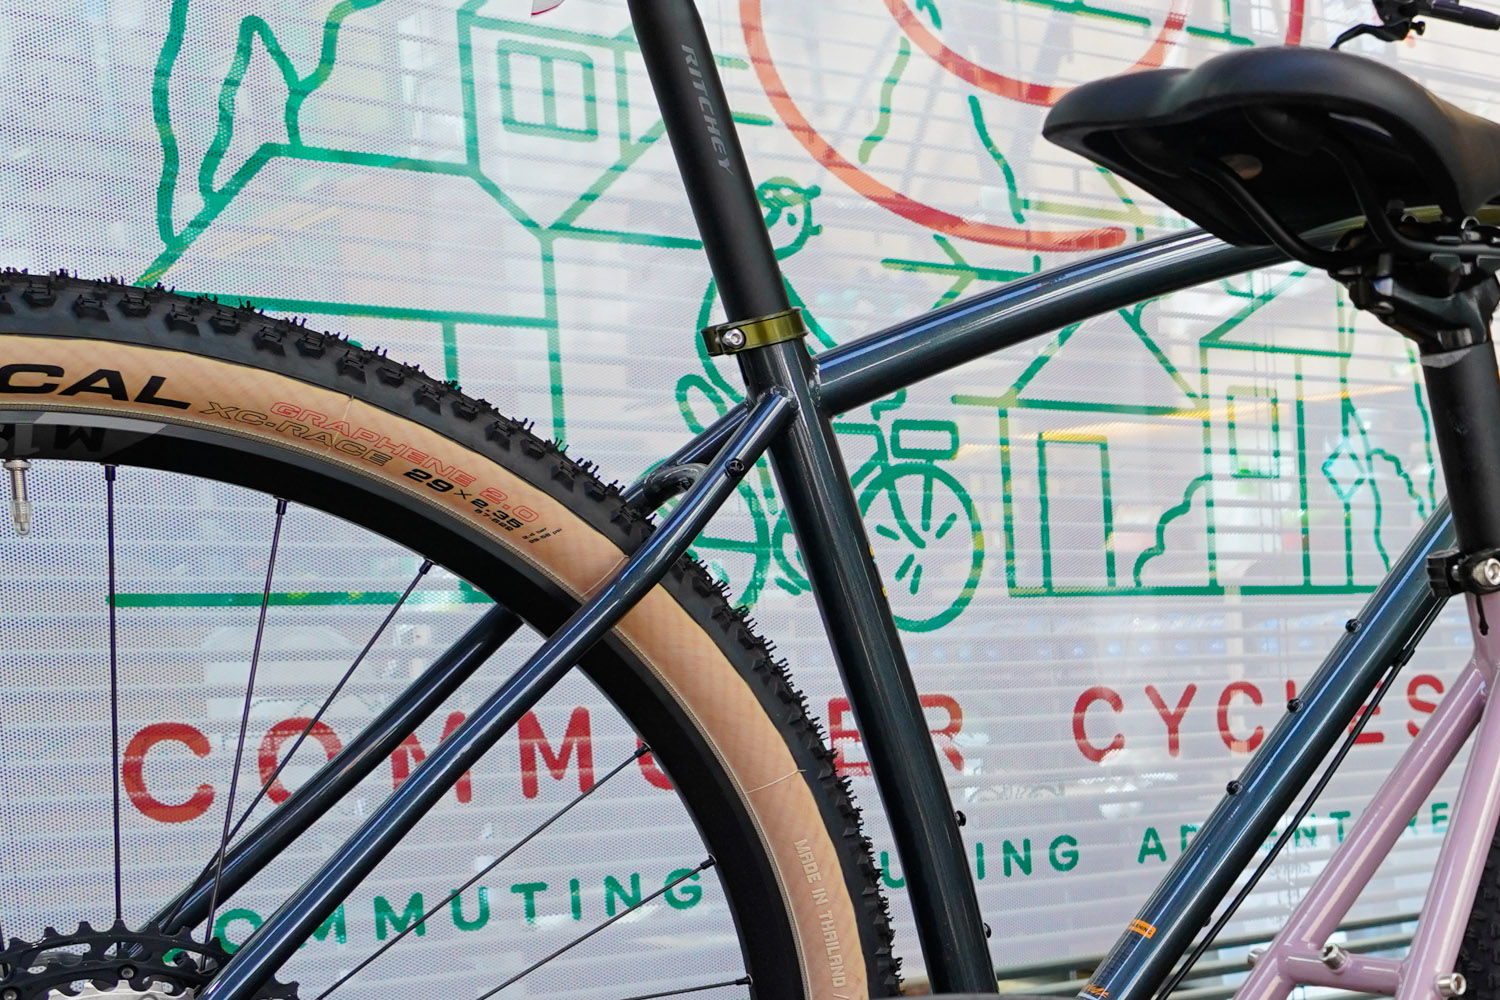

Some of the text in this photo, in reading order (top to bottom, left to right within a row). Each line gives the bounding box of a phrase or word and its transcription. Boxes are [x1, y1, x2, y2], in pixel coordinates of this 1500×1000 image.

[681, 44, 734, 176] RITCHEY
[199, 401, 393, 467] XC-RACE
[270, 401, 540, 523] GRAPHENE 2.0
[402, 468, 455, 493] 29
[470, 498, 525, 529] 2.35
[1072, 673, 1445, 763] CYCES
[794, 838, 822, 884] MADE
[811, 888, 828, 906] IN
[818, 910, 848, 988] THAILAND
